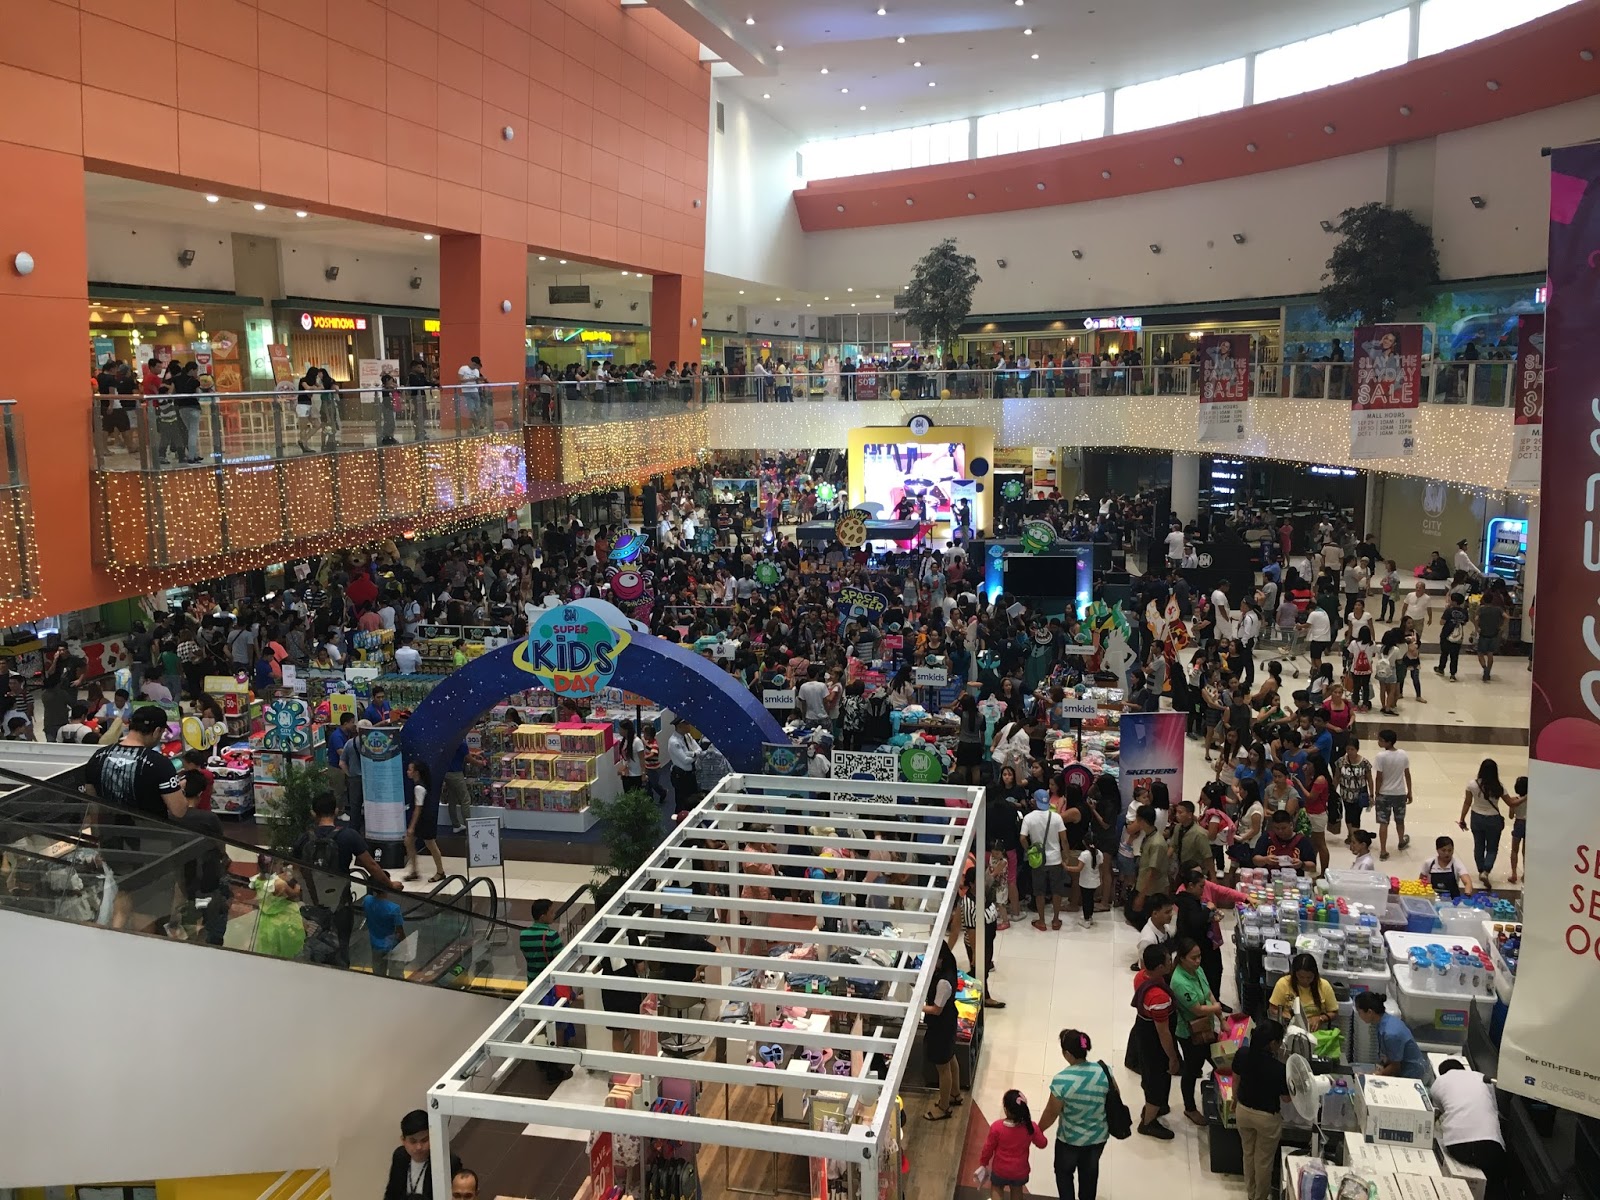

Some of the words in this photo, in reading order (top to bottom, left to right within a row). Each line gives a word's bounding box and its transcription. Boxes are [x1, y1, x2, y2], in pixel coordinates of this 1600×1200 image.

[313, 316, 355, 330] YOSHINOYA
[1358, 367, 1416, 383] PAYDAY
[1204, 381, 1243, 399] SALE
[1358, 382, 1413, 405] SALE
[1422, 519, 1442, 530] CITY
[841, 589, 880, 603] SPACE
[837, 598, 884, 613] RANGER
[553, 625, 588, 634] SUPER
[554, 675, 599, 693] DAY
[917, 673, 944, 681] smkids
[765, 695, 793, 704] smkids
[1064, 704, 1095, 713] smkids
[1126, 768, 1178, 776] SKECHERS
[1525, 1055, 1539, 1064] Per
[1541, 1060, 1581, 1076] DTI-FTEB
